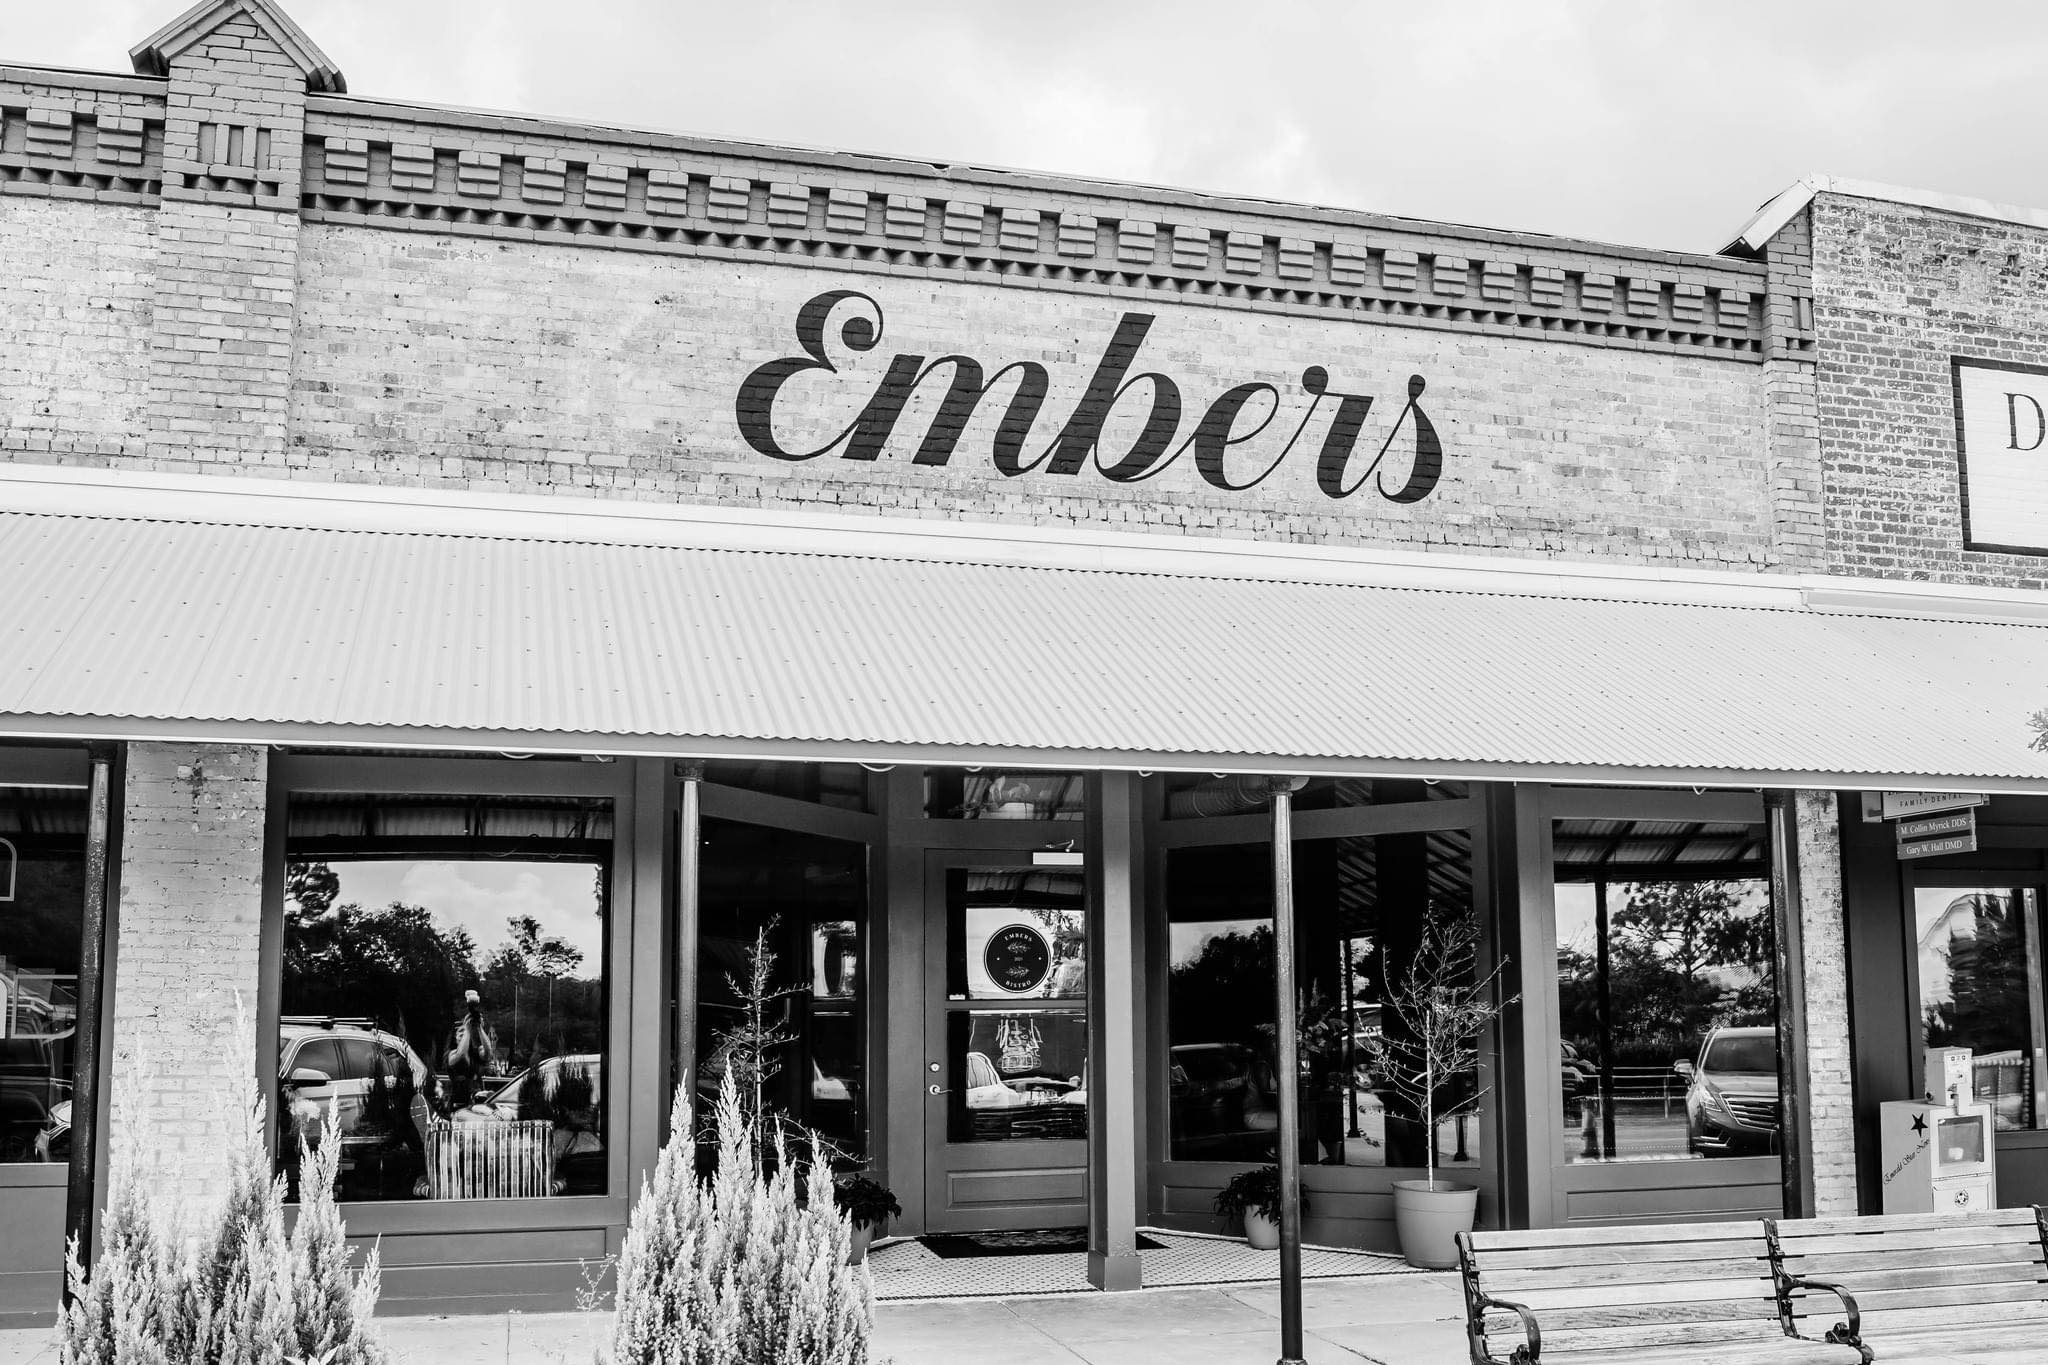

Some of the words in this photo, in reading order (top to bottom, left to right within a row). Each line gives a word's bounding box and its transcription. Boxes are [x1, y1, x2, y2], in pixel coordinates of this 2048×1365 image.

[736, 289, 1443, 505] Embers
[1900, 798, 1928, 807] FAMILY
[1910, 823, 1928, 833] Collin
[1929, 820, 1950, 832] Myrick
[1951, 817, 1967, 828] DDS
[1906, 846, 1920, 856] Gary
[1931, 841, 1944, 852] Hall
[1944, 839, 1963, 850] DMD
[1004, 932, 1033, 942] EMBERS
[1005, 979, 1032, 989] BISTRO
